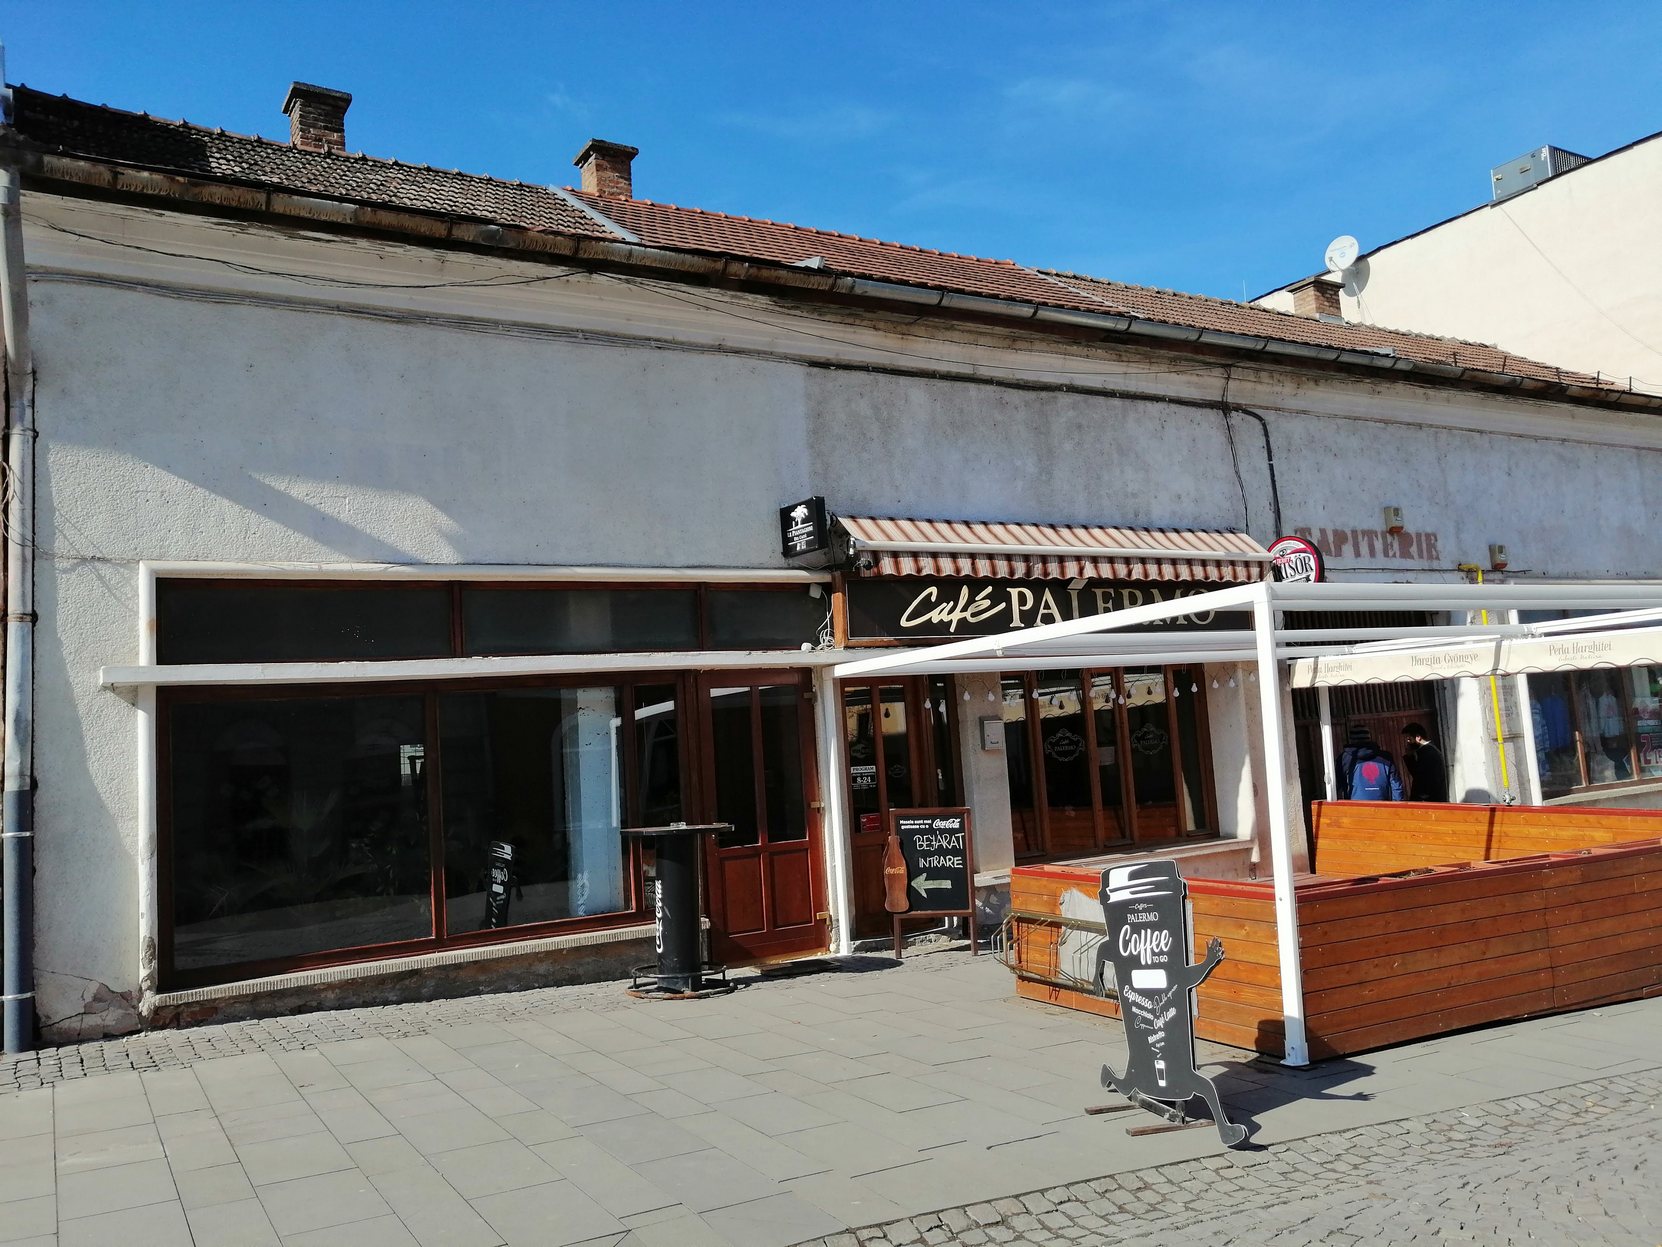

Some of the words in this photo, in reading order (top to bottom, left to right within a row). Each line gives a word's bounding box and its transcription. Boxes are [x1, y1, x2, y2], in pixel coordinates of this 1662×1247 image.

[900, 584, 1006, 633] Café
[1411, 654, 1442, 667] Hargita
[919, 855, 963, 868] INTRARE
[1127, 911, 1159, 923] PALERMO
[1119, 924, 1172, 966] Coffee
[1124, 985, 1153, 1009] Espresso
